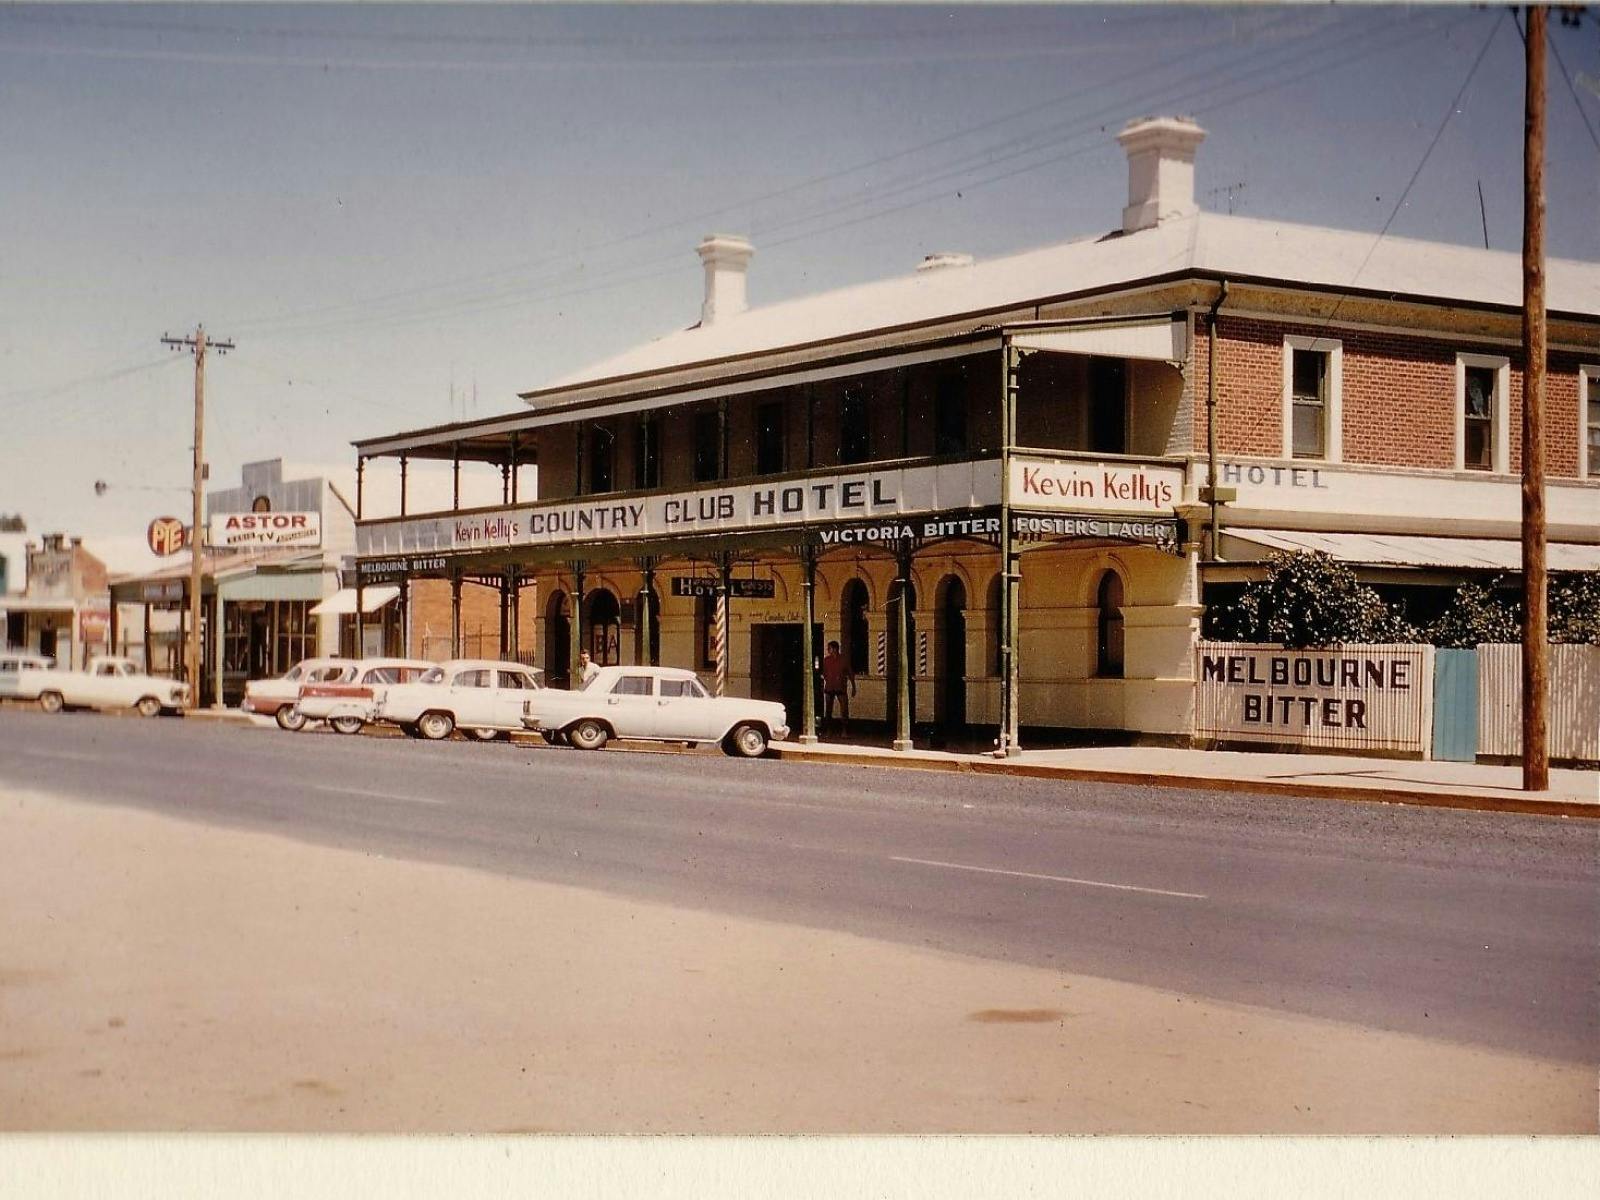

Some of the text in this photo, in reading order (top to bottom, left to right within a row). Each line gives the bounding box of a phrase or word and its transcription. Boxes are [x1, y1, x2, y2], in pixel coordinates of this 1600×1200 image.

[1023, 466, 1172, 508] Kevin Kelly's
[1223, 463, 1328, 489] HOTEL
[226, 515, 307, 530] ASTOR
[455, 479, 897, 543] Kevin Kelly's COUNTRY CLUB HOTEL
[259, 532, 274, 542] TV
[820, 518, 1000, 544] VICTORIA BITTER
[1017, 517, 1166, 538] FOSTER'S LAGER
[361, 558, 446, 573] MELBOURNE BITTER
[680, 578, 740, 596] HOTL
[1202, 655, 1411, 690] MELBOURNE
[1243, 694, 1367, 729] BITTER
